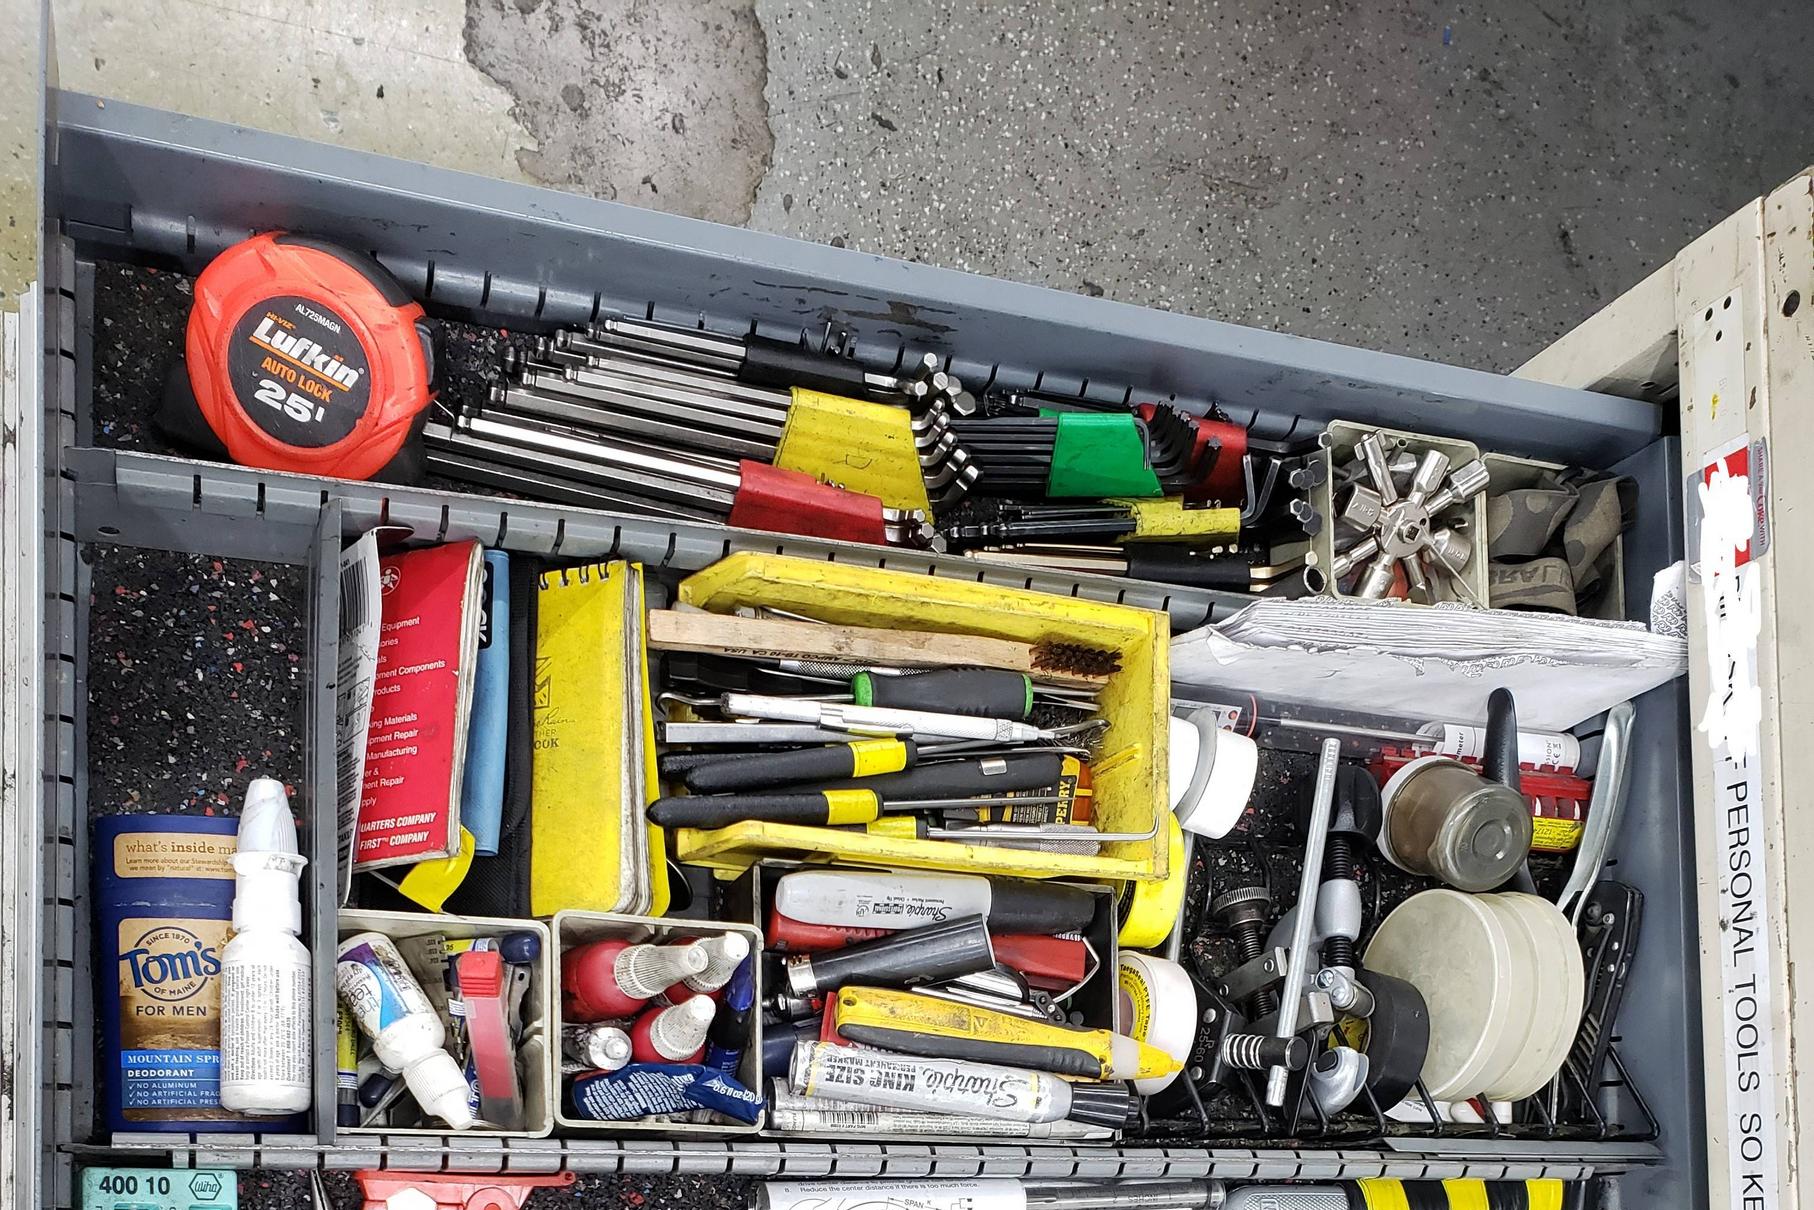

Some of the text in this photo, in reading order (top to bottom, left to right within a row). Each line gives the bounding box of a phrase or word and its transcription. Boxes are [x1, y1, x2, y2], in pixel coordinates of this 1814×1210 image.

[252, 317, 360, 389] Lufkin
[261, 356, 333, 403] AUTO LOCK
[1758, 526, 1766, 546] WITH
[382, 616, 420, 631] Equipment
[380, 638, 398, 648] ories
[398, 660, 445, 675] Components
[374, 685, 400, 696] roducts
[384, 712, 417, 726] Materials
[394, 729, 418, 740] Repair
[1456, 732, 1464, 757] meter
[366, 745, 417, 760] Manufacturing
[380, 776, 404, 787] Repair
[361, 797, 376, 808] pply
[1055, 781, 1070, 824] PERRY
[360, 812, 436, 832] UARTERS COMPANY
[390, 831, 429, 846] COMPANY
[126, 840, 167, 853] what's
[171, 842, 215, 854] inside
[905, 903, 952, 922] Sharpie
[145, 932, 190, 947] SINCE 1970
[121, 940, 221, 989] Tom's
[1723, 783, 1763, 1162] PERSONAL TOOLS SO
[154, 979, 197, 996] OF MAINE
[136, 1005, 207, 1017] FOR MEN
[128, 1055, 219, 1063] MOUNTAIN SPR
[827, 1056, 916, 1073] PERMANENT MARKER
[824, 1064, 1029, 1108] Sharpie KING SIZE
[99, 1175, 138, 1195] 400
[146, 1177, 171, 1195] 10
[903, 1199, 922, 1208] SPAN
